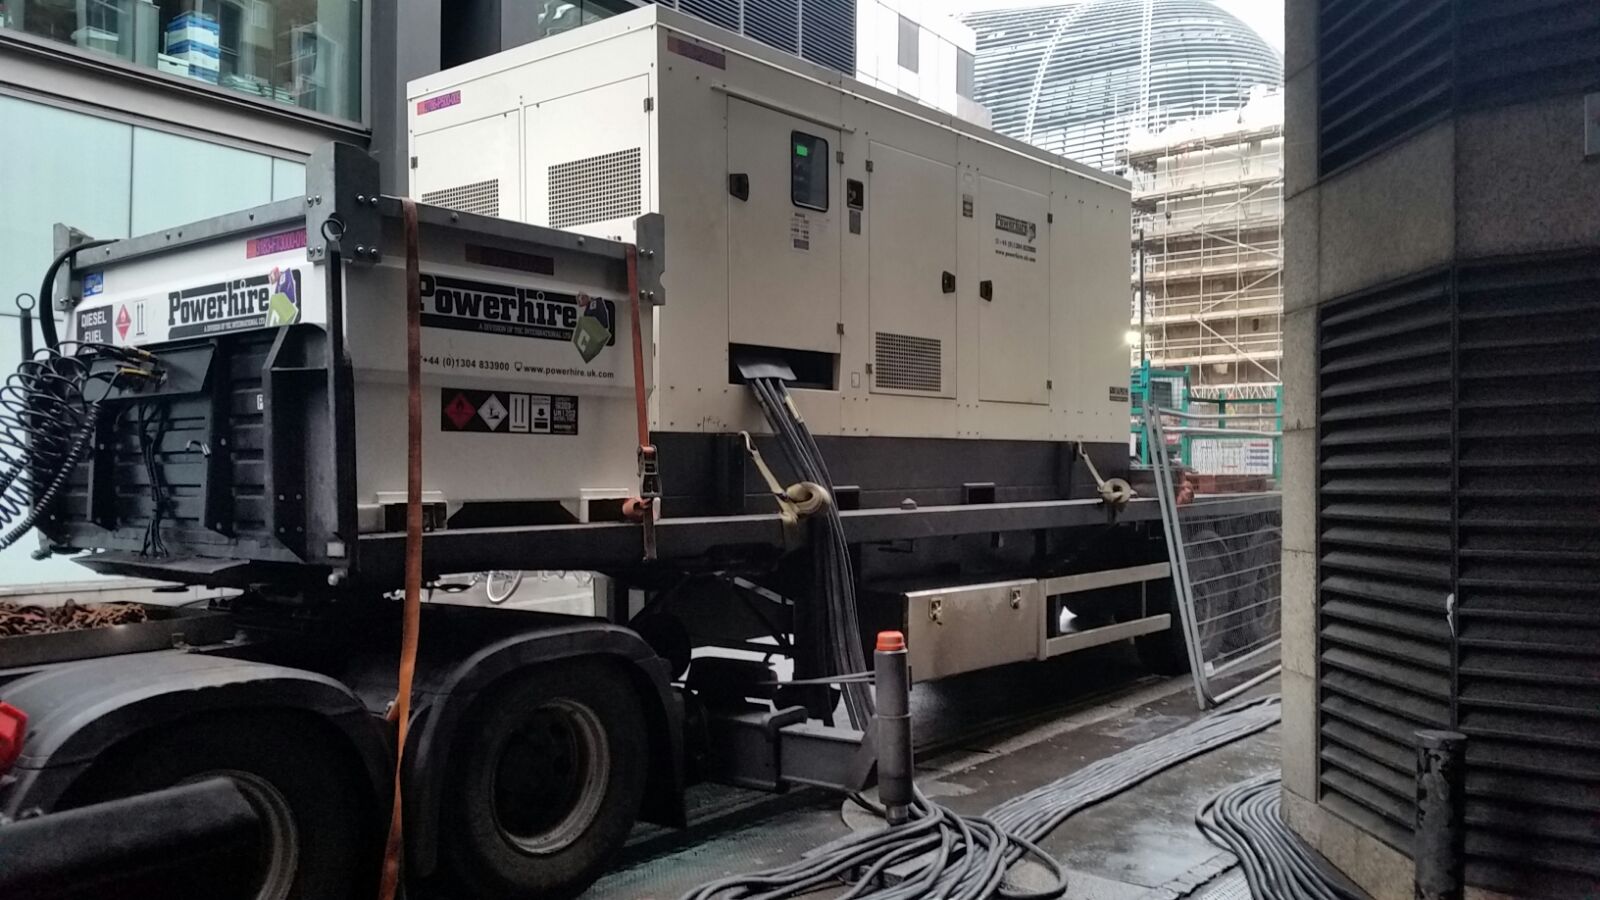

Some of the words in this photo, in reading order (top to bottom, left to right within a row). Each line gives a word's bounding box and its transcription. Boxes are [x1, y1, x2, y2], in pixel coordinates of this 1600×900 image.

[168, 279, 269, 326] Powerhire
[419, 273, 577, 328] Powerhire
[81, 310, 107, 328] DIESEL
[84, 330, 104, 343] FUEL
[423, 356, 439, 365] +44
[442, 357, 477, 368] (0)1304
[479, 360, 510, 371] 833900
[523, 366, 614, 378] www.powerhire.uk.com
